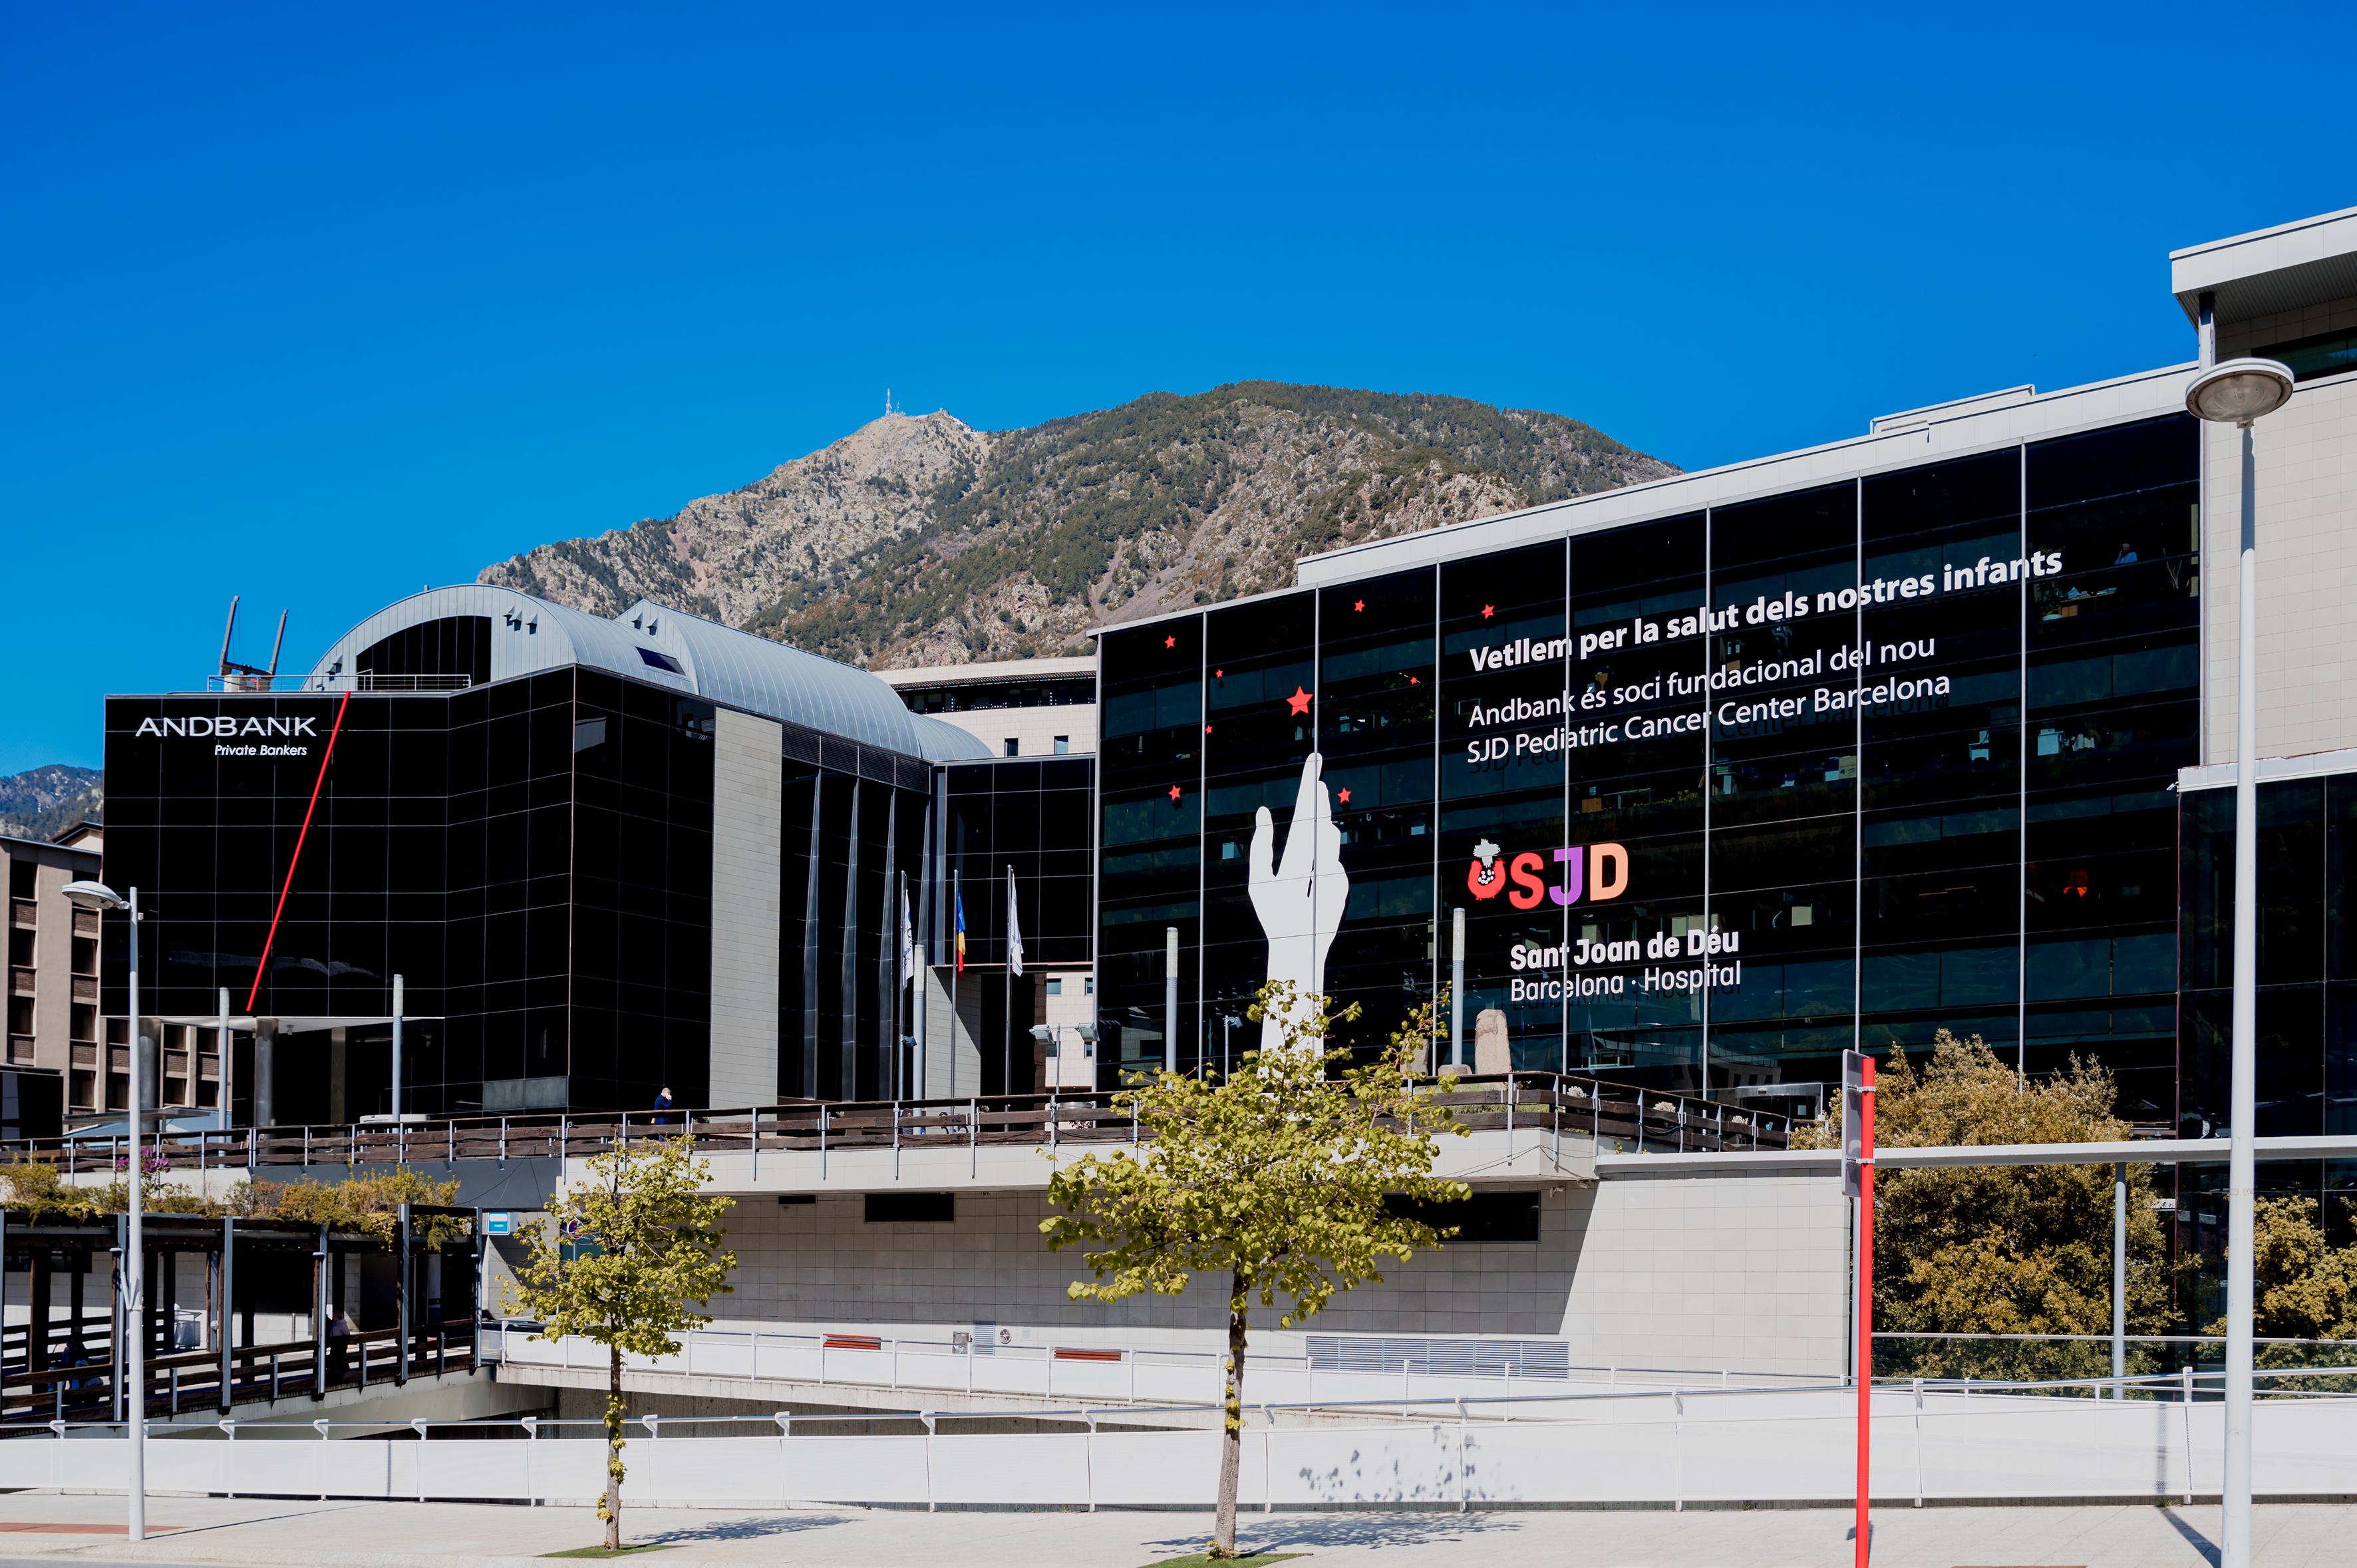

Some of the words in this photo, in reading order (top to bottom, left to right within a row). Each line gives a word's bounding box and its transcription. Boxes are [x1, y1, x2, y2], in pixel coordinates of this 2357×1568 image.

[1469, 637, 1573, 671] Vetllem
[1580, 627, 1627, 660] per
[1635, 618, 1658, 645] la
[1666, 604, 1739, 639] salut
[1746, 591, 1809, 625] dels
[1817, 574, 1935, 613] nostres
[1944, 551, 2062, 591] infants
[1468, 689, 1575, 728] Andbank
[1581, 686, 1607, 710] és
[1613, 676, 1660, 705] soci
[1666, 649, 1821, 697] fundacional
[1829, 641, 1871, 671] del
[1881, 638, 1935, 663] nou
[135, 716, 317, 737] ANDBANK
[1468, 737, 1509, 763] SJD
[1516, 722, 1618, 756] Pediatric
[1625, 710, 1712, 739] Cancer
[1718, 697, 1806, 726] Center
[1814, 676, 1950, 712] Barcelona
[214, 744, 257, 756] Private
[260, 744, 307, 756] Bankers
[1510, 942, 1570, 970] Sant
[1573, 938, 1640, 965] Joan
[1647, 931, 1680, 959] de
[1687, 924, 1739, 956] Déu
[1511, 973, 1623, 1002] Barcelona
[1645, 960, 1740, 995] Hospital
